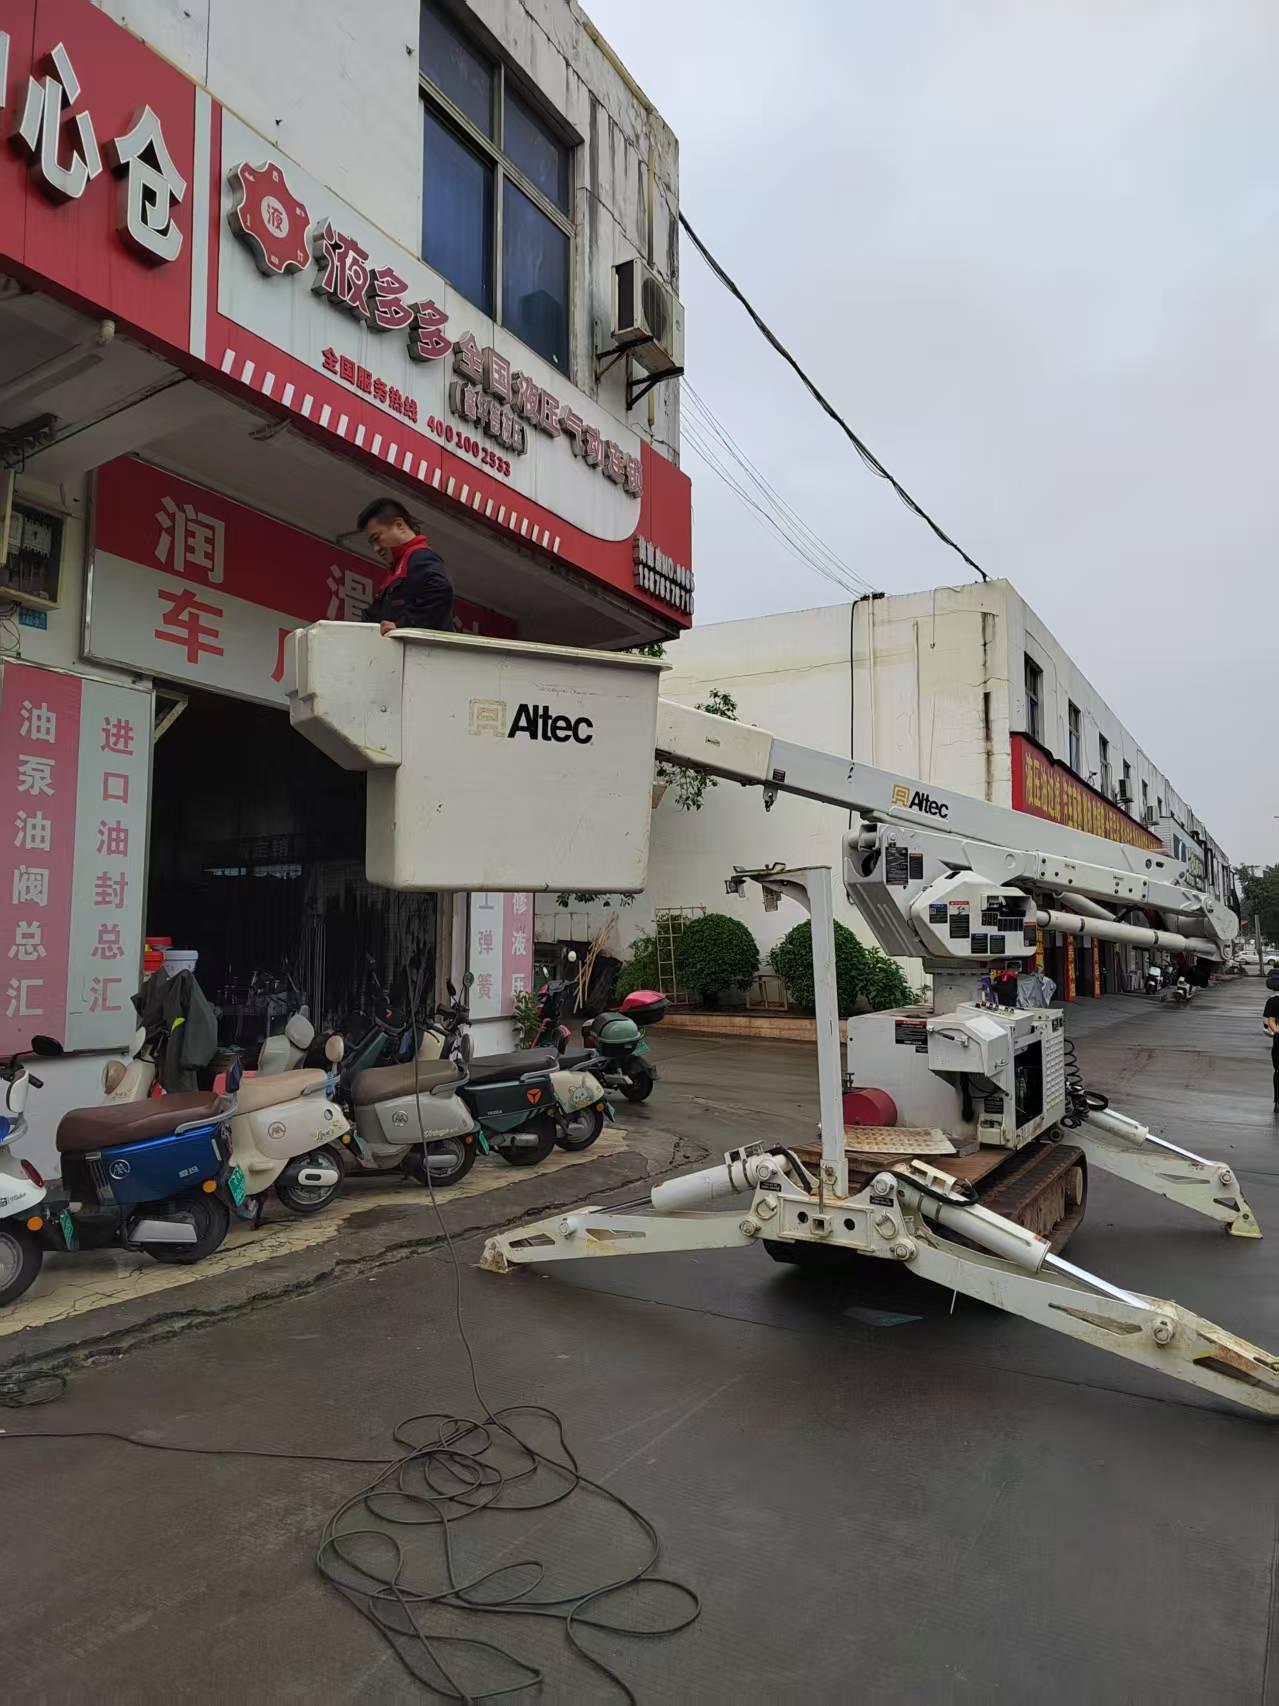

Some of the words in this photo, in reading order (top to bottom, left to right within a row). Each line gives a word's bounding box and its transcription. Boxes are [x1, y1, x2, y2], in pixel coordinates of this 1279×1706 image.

[0, 31, 187, 261] 心仓
[321, 223, 453, 361] 液多多
[321, 347, 419, 424] 全国服务热线
[507, 703, 594, 744] Altec
[6, 700, 57, 1019] 油泵油阀总汇
[88, 716, 135, 1013] 进口油封总汇
[909, 791, 949, 819] Altec
